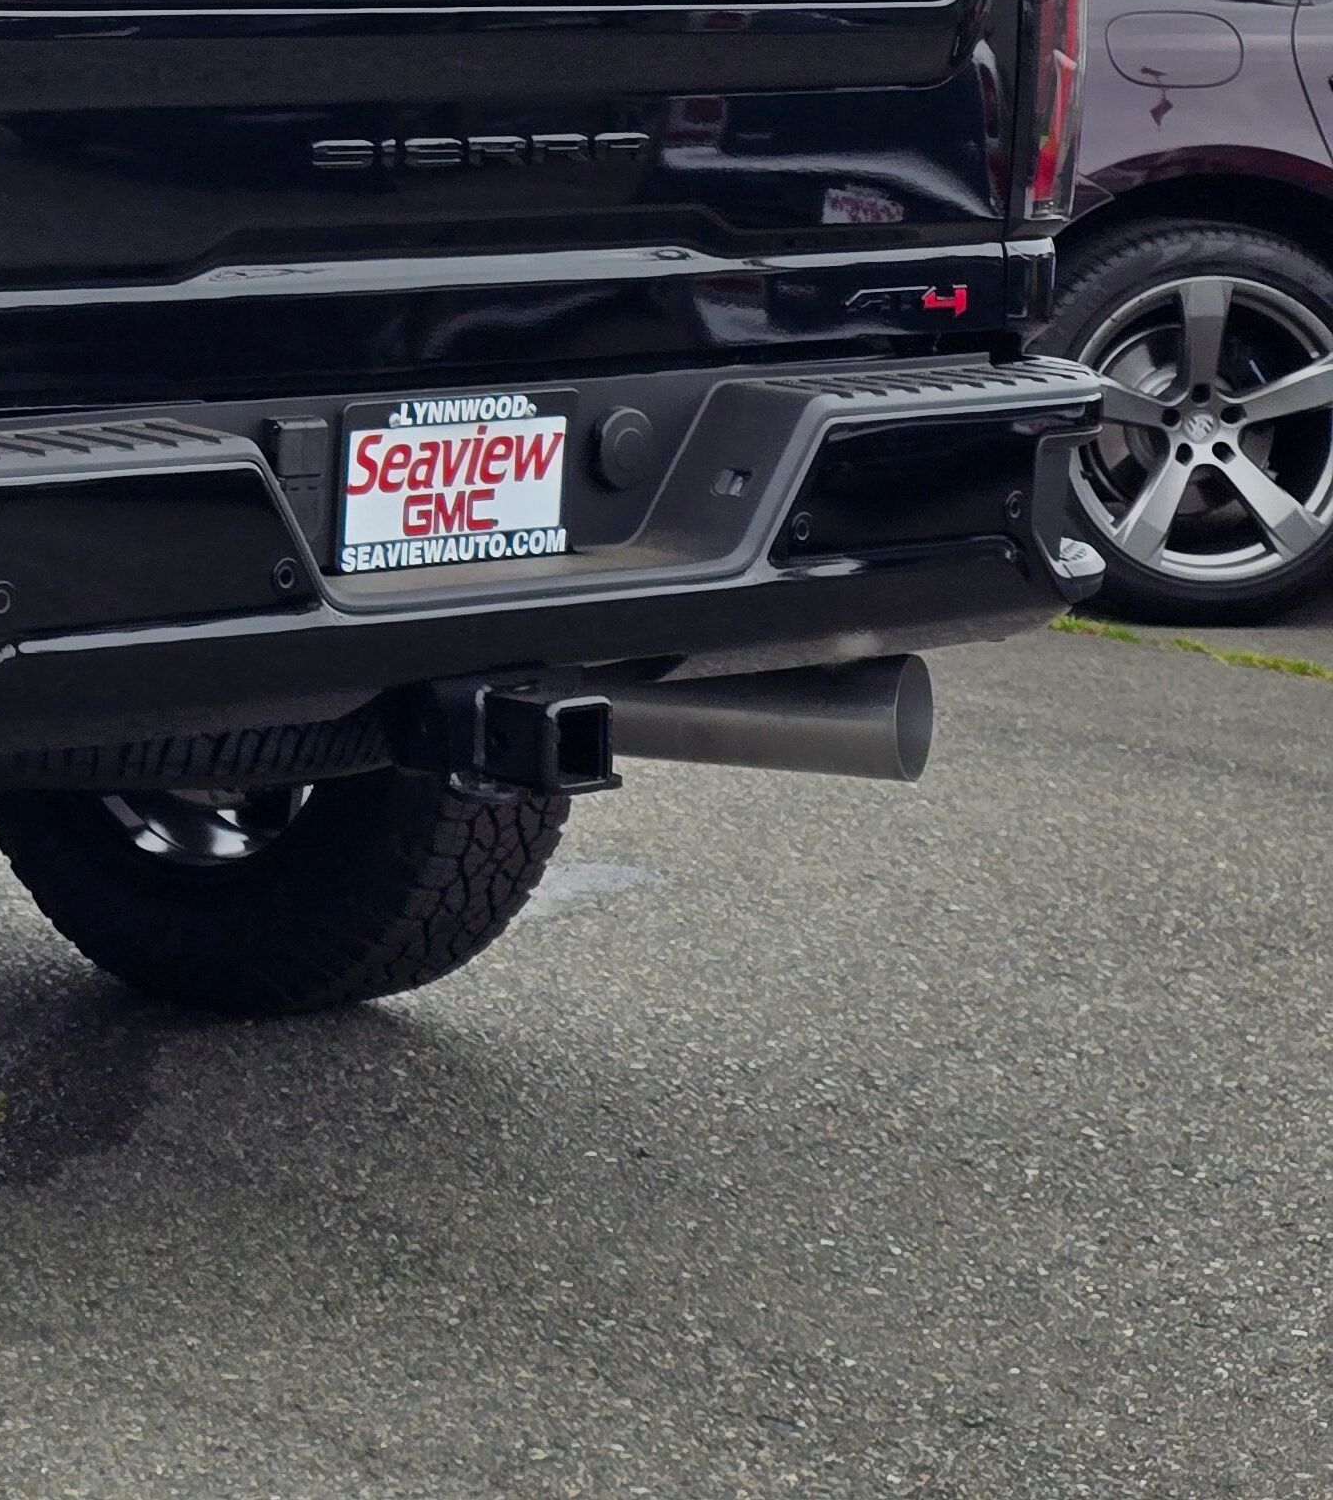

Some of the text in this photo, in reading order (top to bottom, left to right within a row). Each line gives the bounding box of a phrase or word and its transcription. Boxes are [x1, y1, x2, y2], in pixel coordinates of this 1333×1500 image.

[312, 132, 650, 169] SIERRA
[842, 284, 969, 316] AT4
[400, 395, 529, 426] LYNNWOOD
[346, 424, 564, 496] Seaview
[403, 488, 496, 537] GMC
[341, 528, 567, 573] SEAVIEWAUTO.COM
